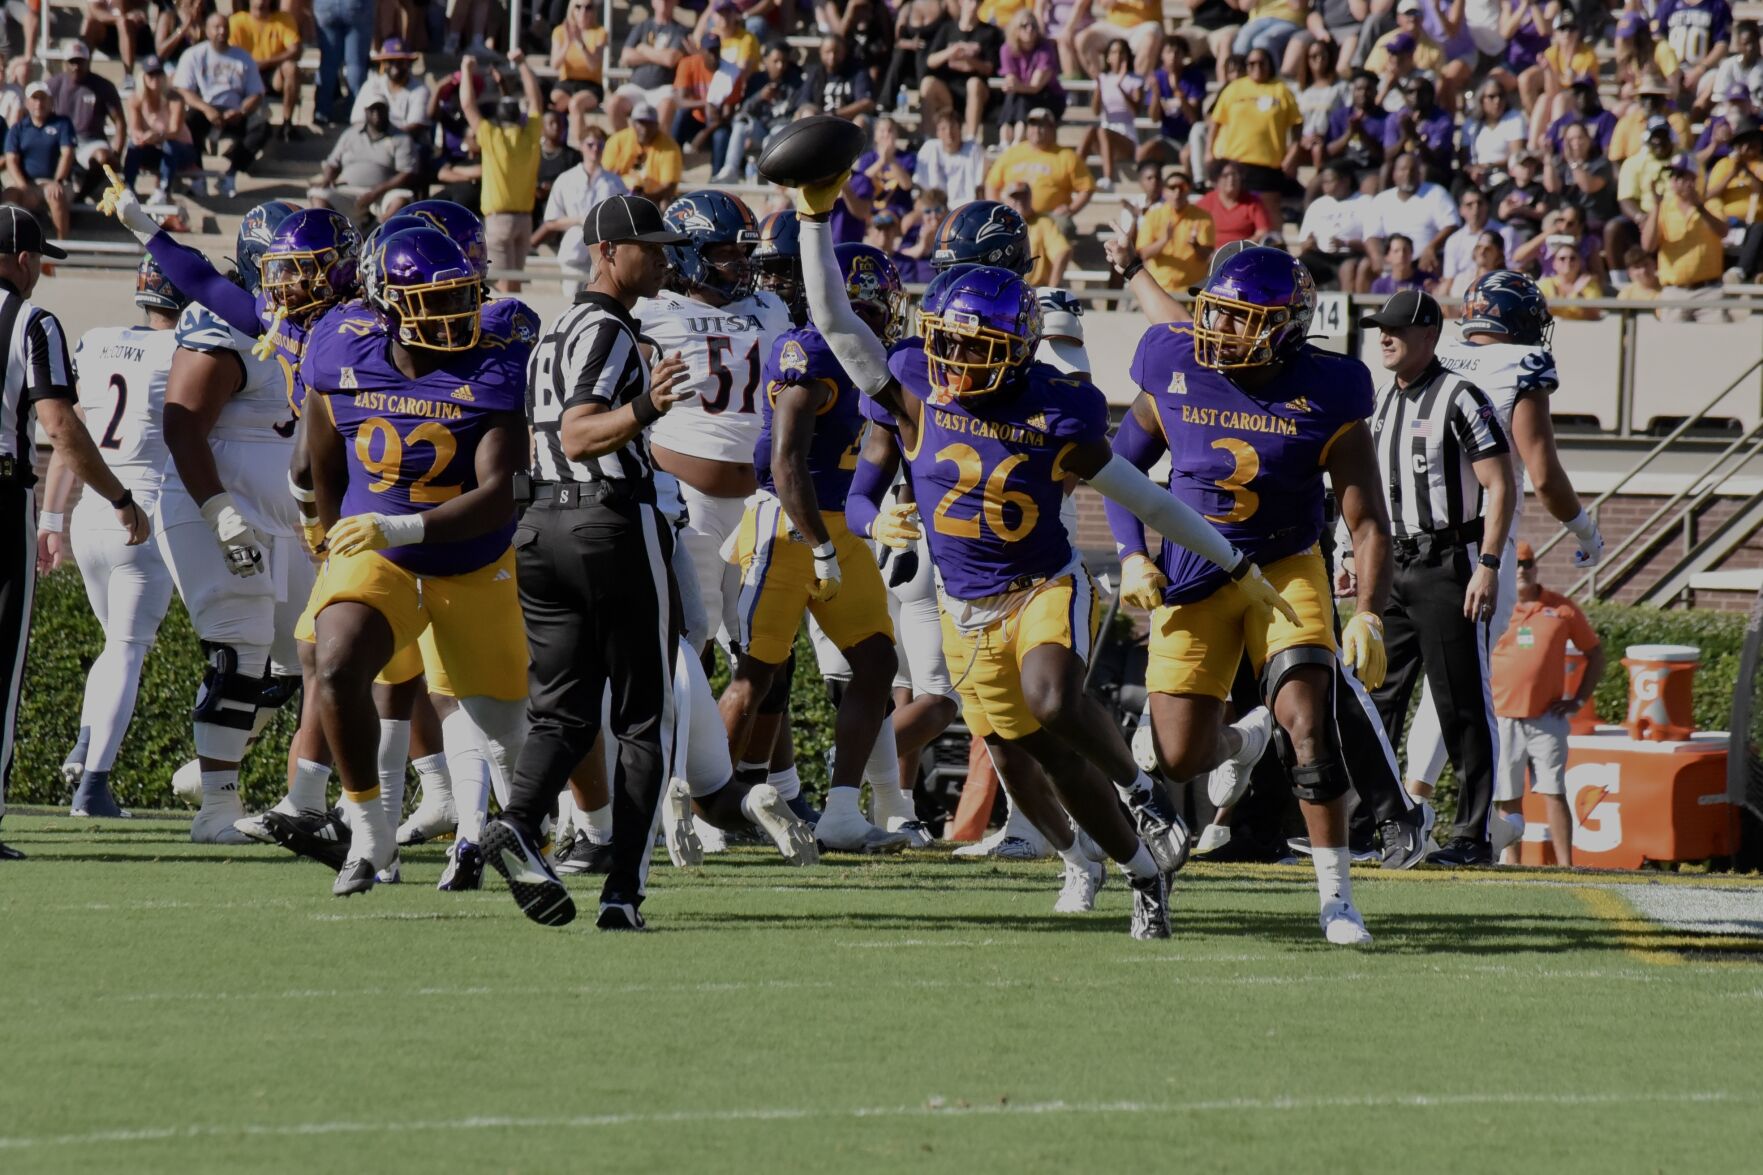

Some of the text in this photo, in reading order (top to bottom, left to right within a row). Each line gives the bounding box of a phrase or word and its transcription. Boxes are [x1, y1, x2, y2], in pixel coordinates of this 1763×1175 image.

[687, 314, 765, 333] UTSA
[1317, 301, 1339, 330] 14
[700, 335, 761, 415] 51
[99, 373, 126, 450] 2
[353, 391, 462, 420] EAST CAROLINA
[1182, 405, 1298, 436] EAST CAROLINA
[935, 410, 1045, 446] EAST CAROLINA
[355, 416, 462, 503] 92
[1412, 454, 1427, 473] C
[560, 489, 569, 504] S
[933, 442, 1040, 542] 26
[1203, 437, 1260, 524] 3
[1633, 667, 1660, 701] G
[1564, 762, 1622, 853] G
